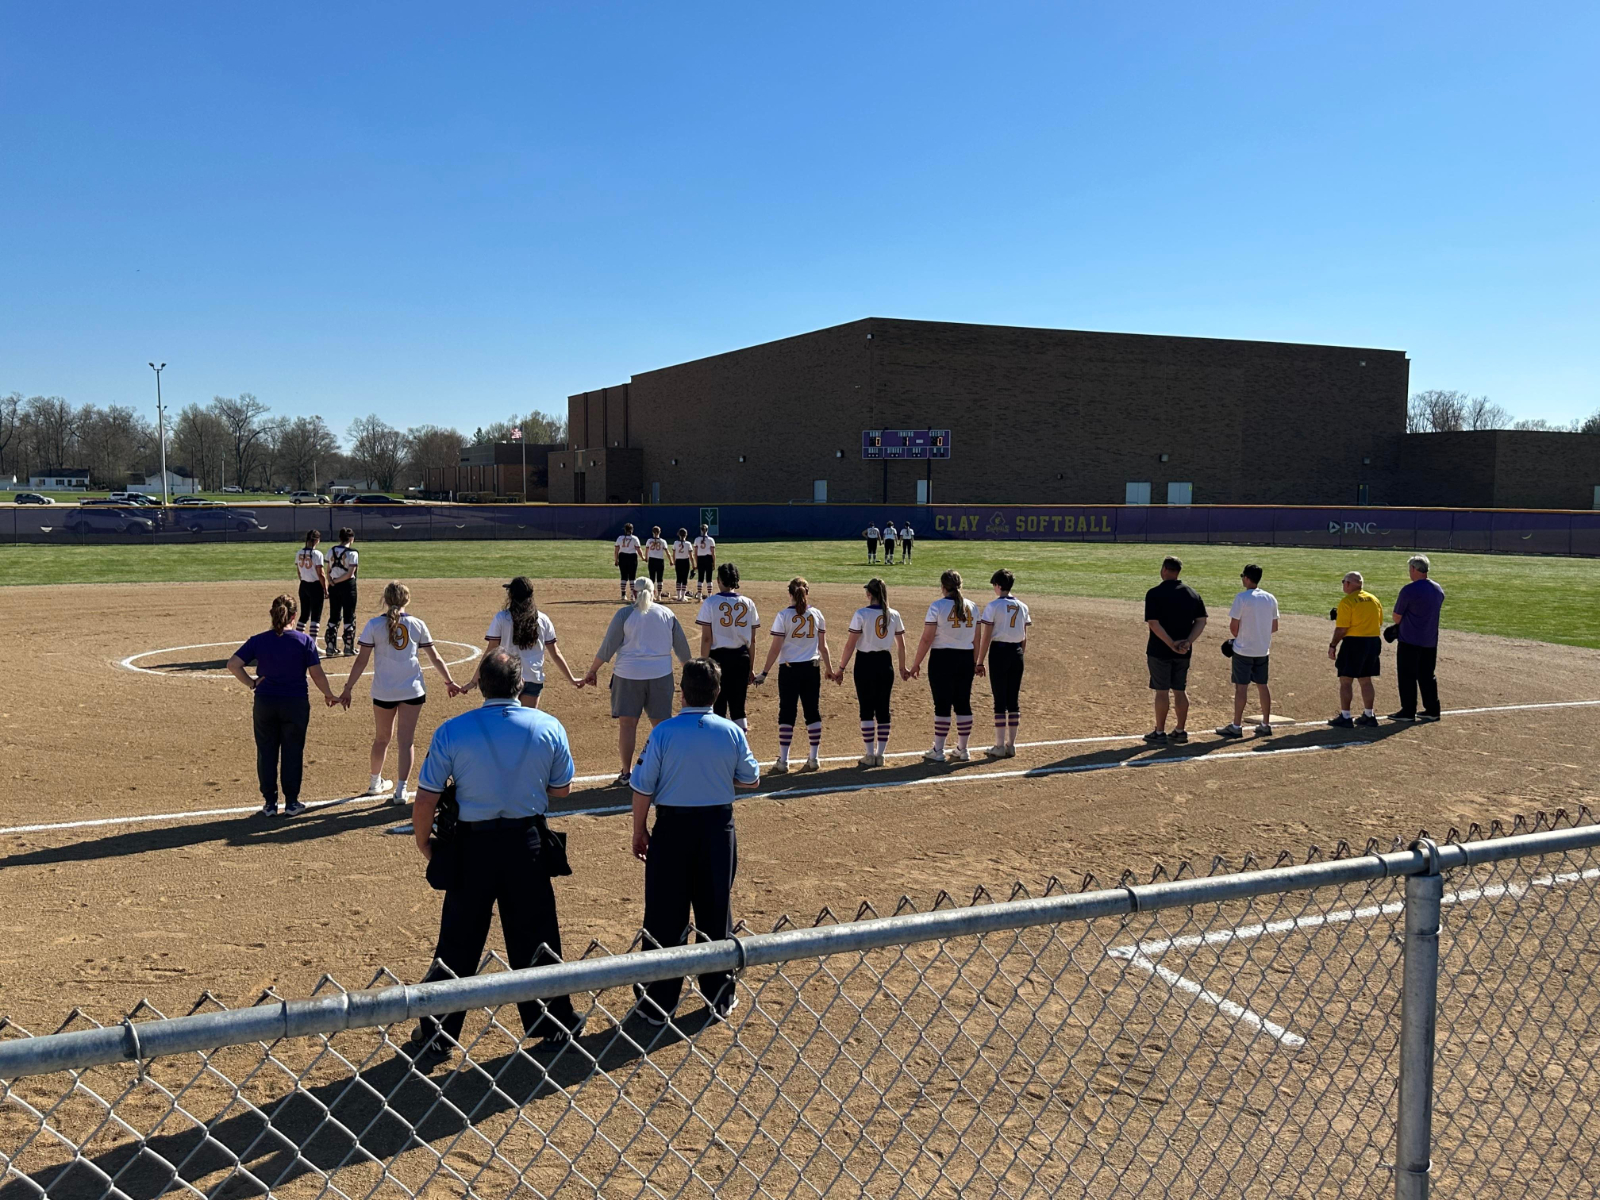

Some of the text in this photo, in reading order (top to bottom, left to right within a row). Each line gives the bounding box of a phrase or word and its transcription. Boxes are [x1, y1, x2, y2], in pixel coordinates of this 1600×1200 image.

[935, 515, 980, 531] CLAY
[1016, 516, 1111, 532] SOFTBALL
[1343, 521, 1377, 534] PNC
[621, 538, 632, 548] 17
[719, 602, 748, 627] 32
[792, 614, 815, 638] 21
[1007, 604, 1019, 628] 7
[392, 623, 409, 650] 9
